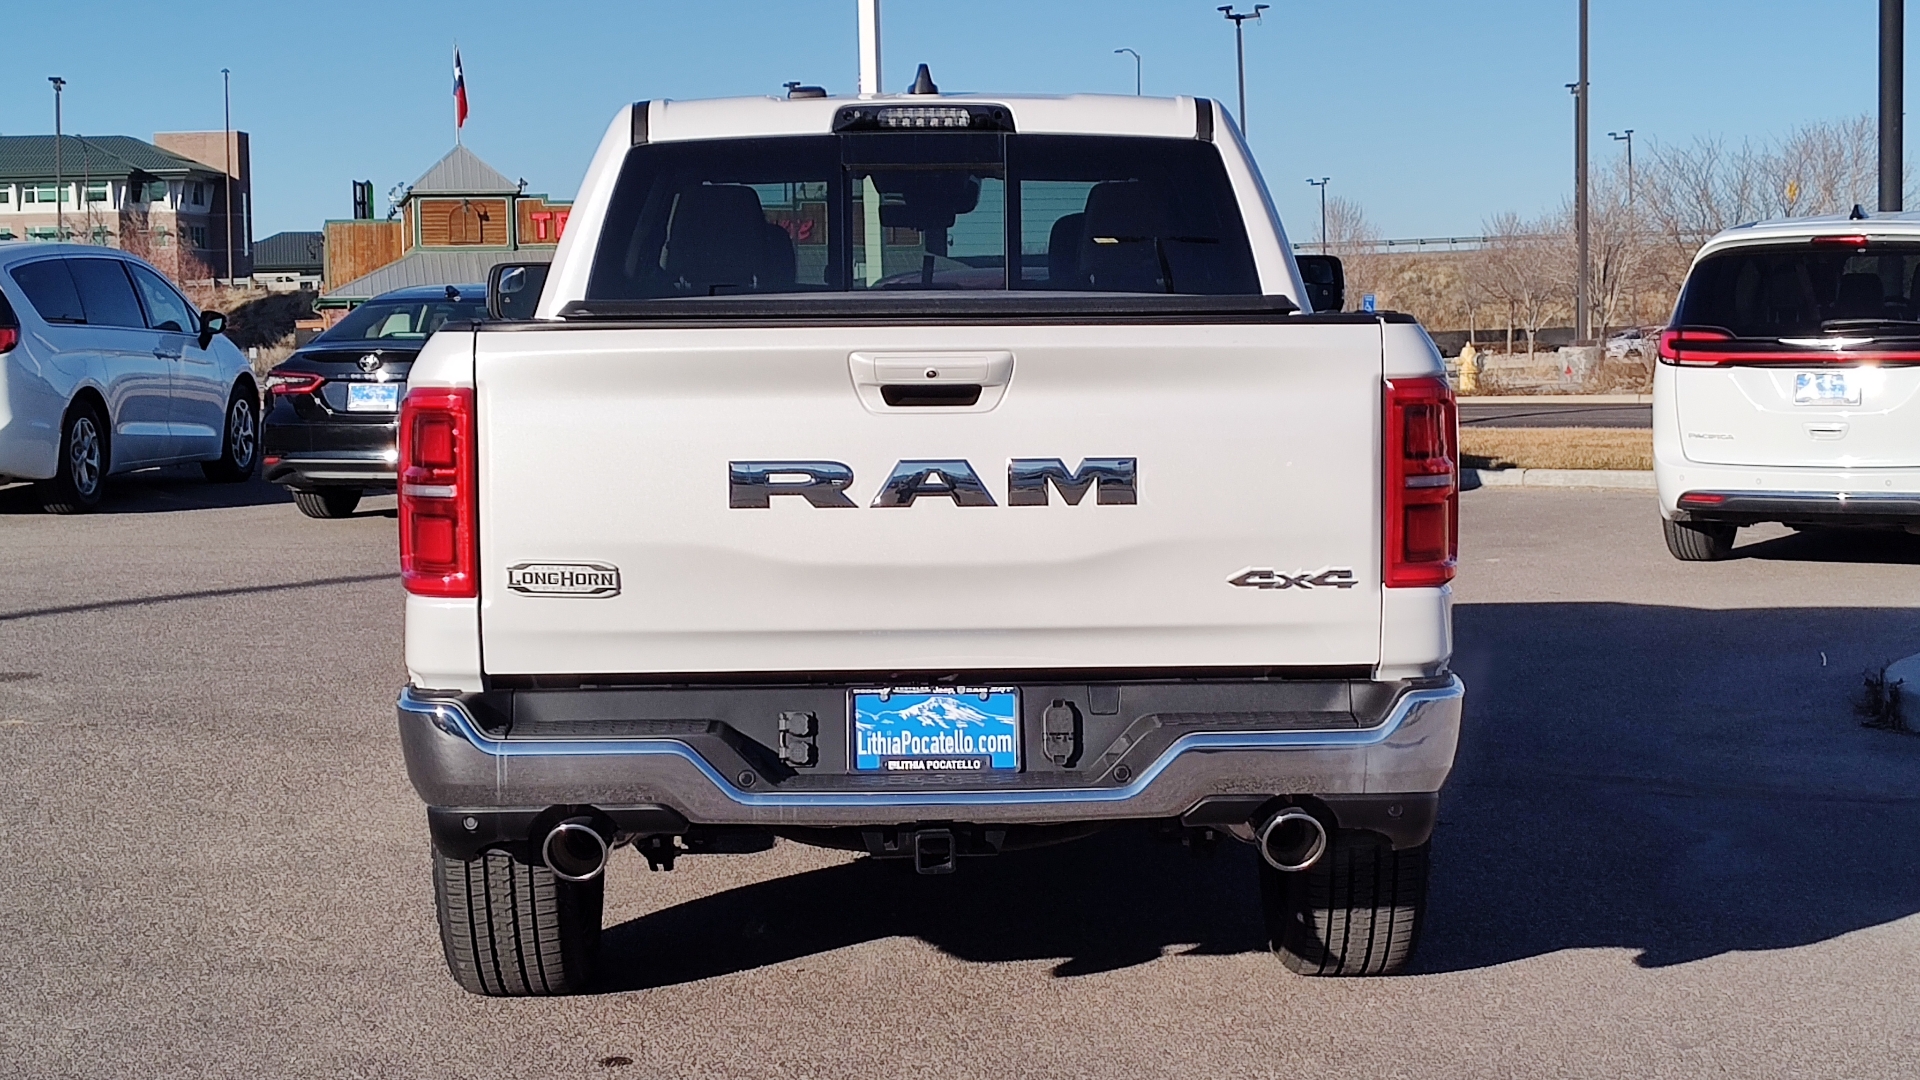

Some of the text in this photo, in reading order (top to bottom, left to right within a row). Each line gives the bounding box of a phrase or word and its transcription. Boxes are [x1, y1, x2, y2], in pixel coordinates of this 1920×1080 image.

[728, 457, 1138, 509] RAM
[508, 570, 615, 587] LONGHORN
[857, 729, 1012, 756] LithiaPocatello.com
[926, 759, 981, 770] POCATELLO
